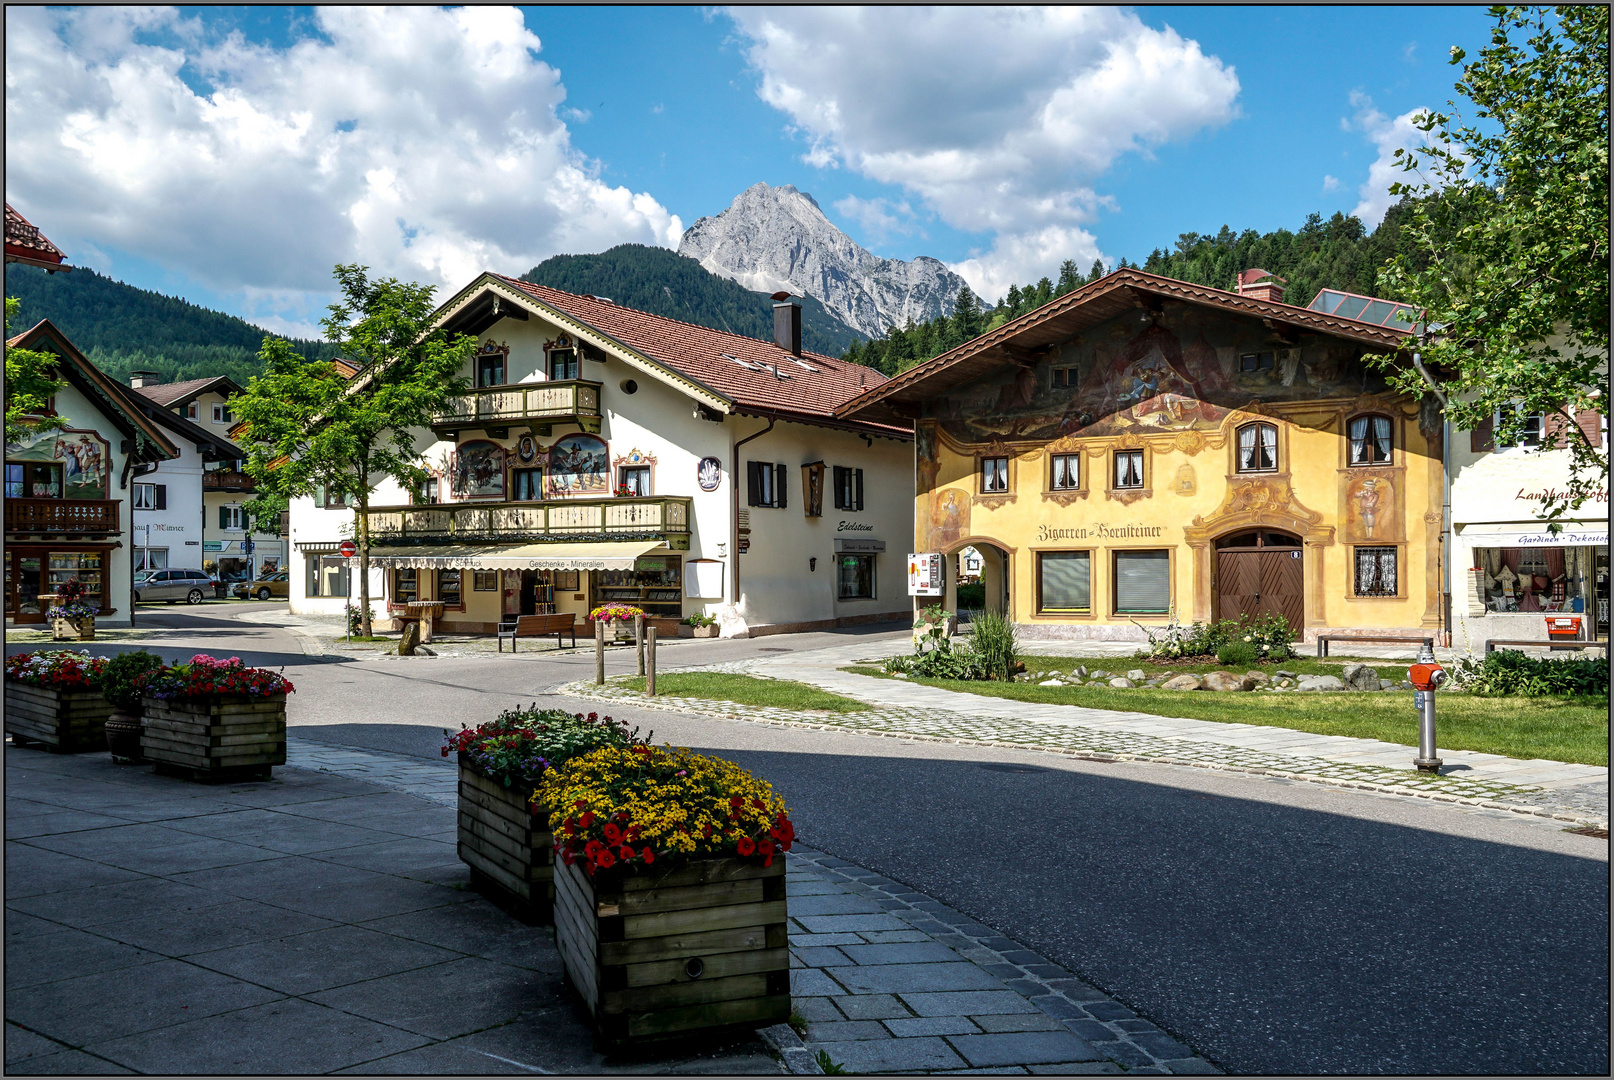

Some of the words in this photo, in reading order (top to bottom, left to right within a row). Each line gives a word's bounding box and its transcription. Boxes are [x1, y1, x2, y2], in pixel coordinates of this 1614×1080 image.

[837, 520, 874, 532] Edelsteine
[1036, 523, 1087, 541] Zigarren
[1093, 522, 1166, 540] Hornsteiner
[1518, 535, 1559, 545] Gardinen
[529, 560, 565, 568] Geschenke
[570, 560, 605, 568] Mineralien
